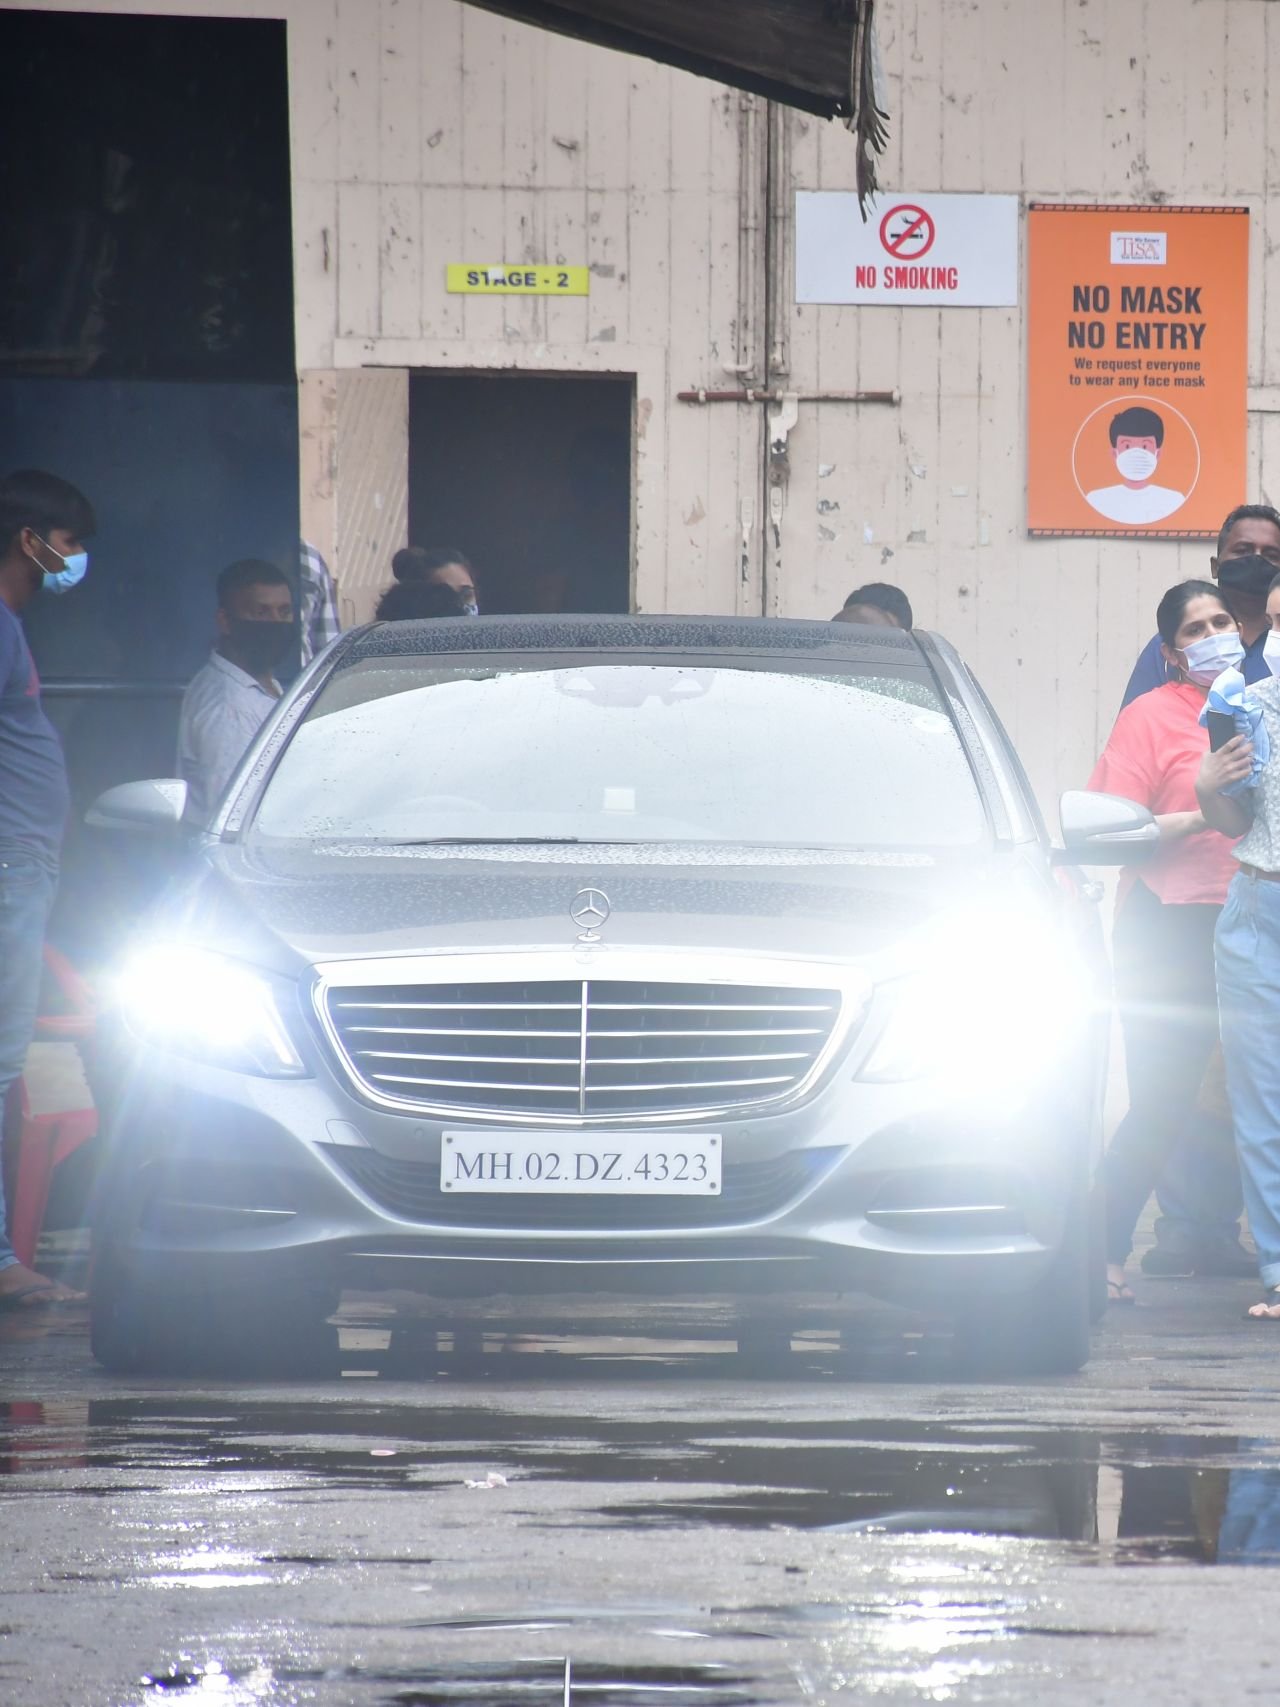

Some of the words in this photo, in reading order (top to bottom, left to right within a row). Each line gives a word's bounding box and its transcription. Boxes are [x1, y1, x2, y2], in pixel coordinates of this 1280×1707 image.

[557, 272, 569, 287] 2
[856, 265, 877, 289] NO
[883, 265, 958, 290] SMOKING
[1073, 285, 1110, 313] NO
[1121, 286, 1202, 314] MASK
[1068, 321, 1105, 349] NO
[1116, 322, 1206, 350] ENTRY
[1074, 357, 1093, 370] We
[1096, 358, 1142, 372] request
[1146, 361, 1201, 373] everyone
[1069, 374, 1081, 386] to
[1085, 376, 1115, 386] wear
[1118, 378, 1140, 389] any
[1143, 375, 1171, 387] face
[1174, 376, 1205, 388] mask
[454, 1152, 708, 1181] MH.02.DZ.4323
